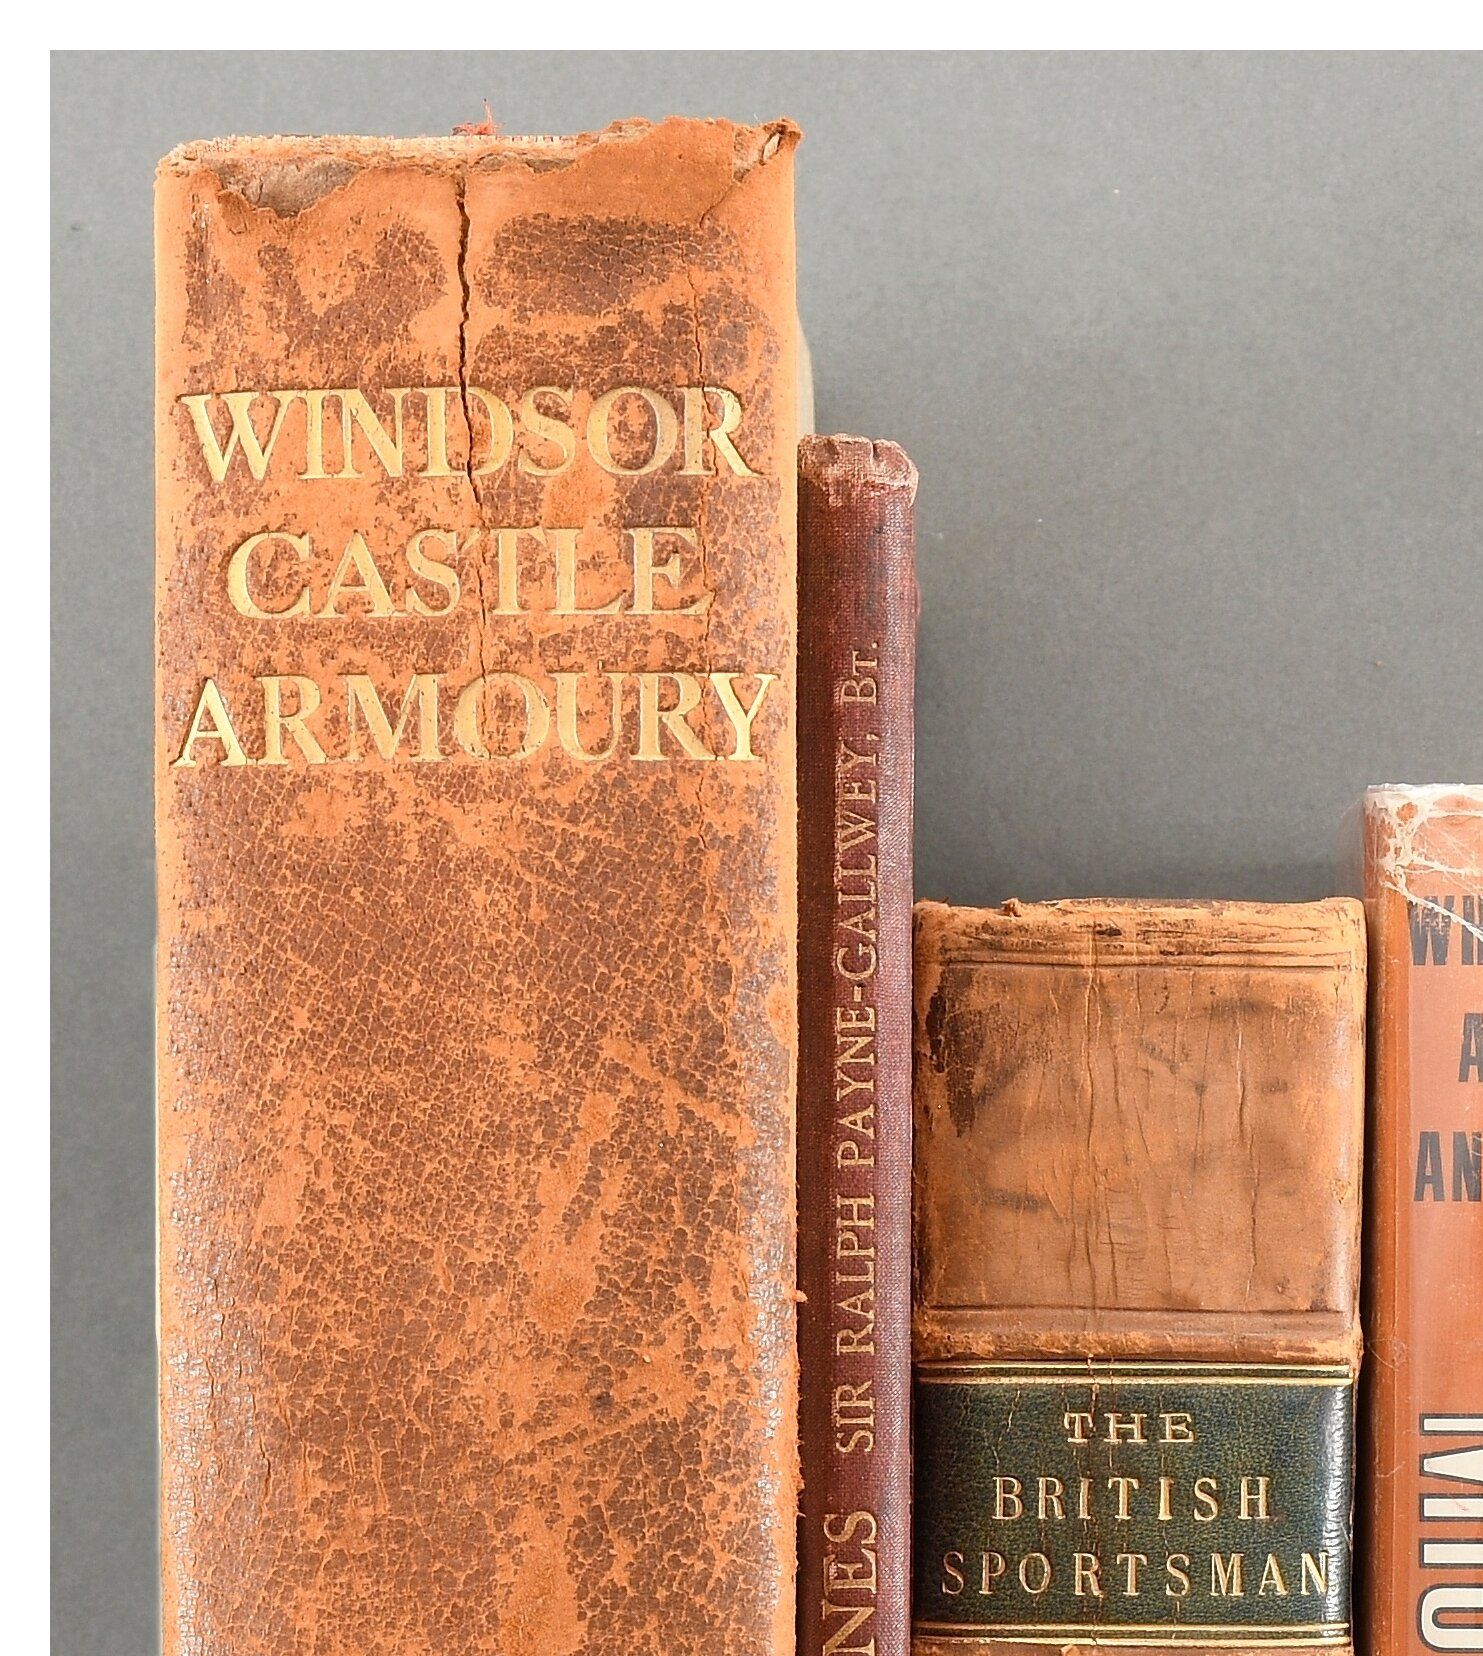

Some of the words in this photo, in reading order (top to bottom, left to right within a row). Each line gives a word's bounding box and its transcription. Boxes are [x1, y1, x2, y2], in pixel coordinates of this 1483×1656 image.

[180, 384, 773, 483] WINDSOR
[225, 526, 713, 620] CASTLE
[170, 672, 781, 769] ARMOURY
[836, 732, 880, 1167] PAYNE-GALLWEY,
[836, 1196, 878, 1355] RALPH
[836, 1382, 878, 1454] SIR
[1064, 1413, 1194, 1443] THE
[992, 1477, 1270, 1521] BRITISH
[942, 1551, 1328, 1597] SPORTSMAN
